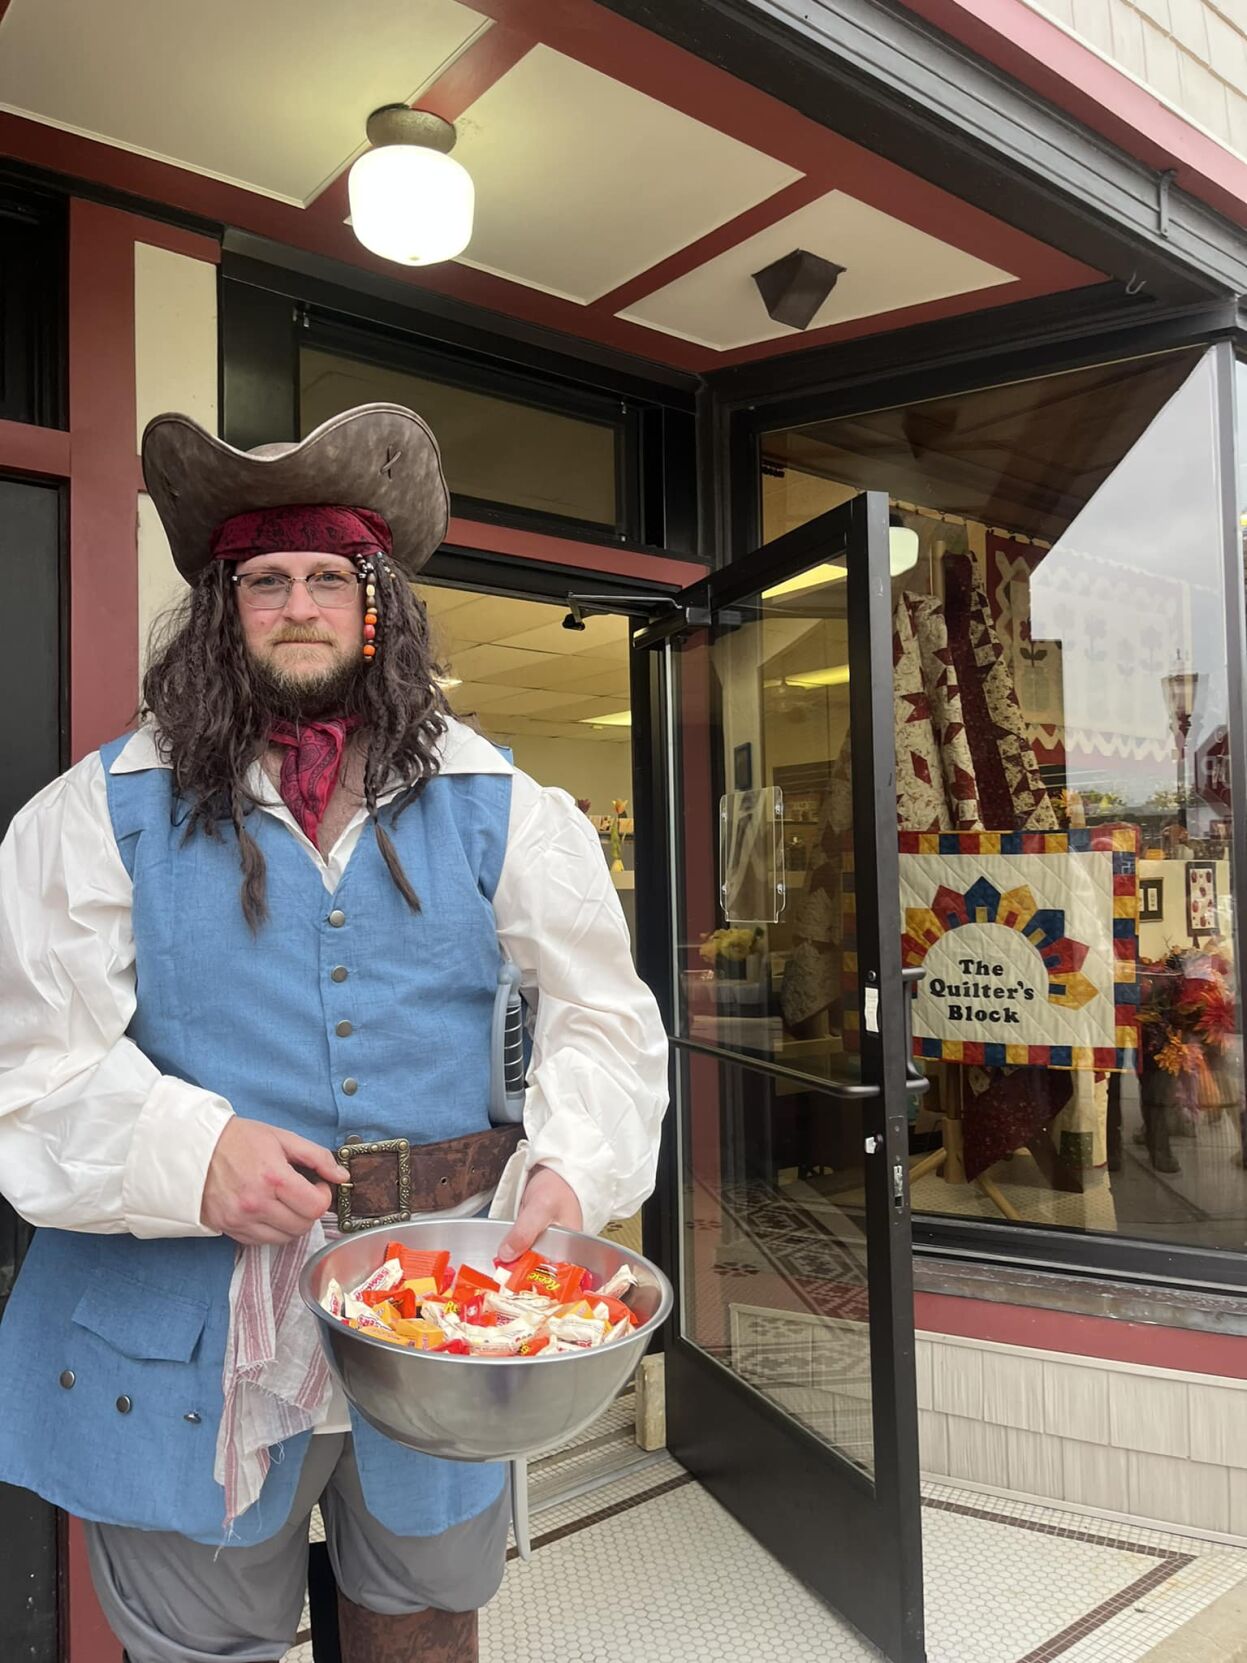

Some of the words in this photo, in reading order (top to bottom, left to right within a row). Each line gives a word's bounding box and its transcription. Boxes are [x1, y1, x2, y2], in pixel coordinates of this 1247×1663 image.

[958, 959, 1004, 977] The
[929, 978, 1034, 1001] Quilter's
[947, 1004, 1021, 1024] Block
